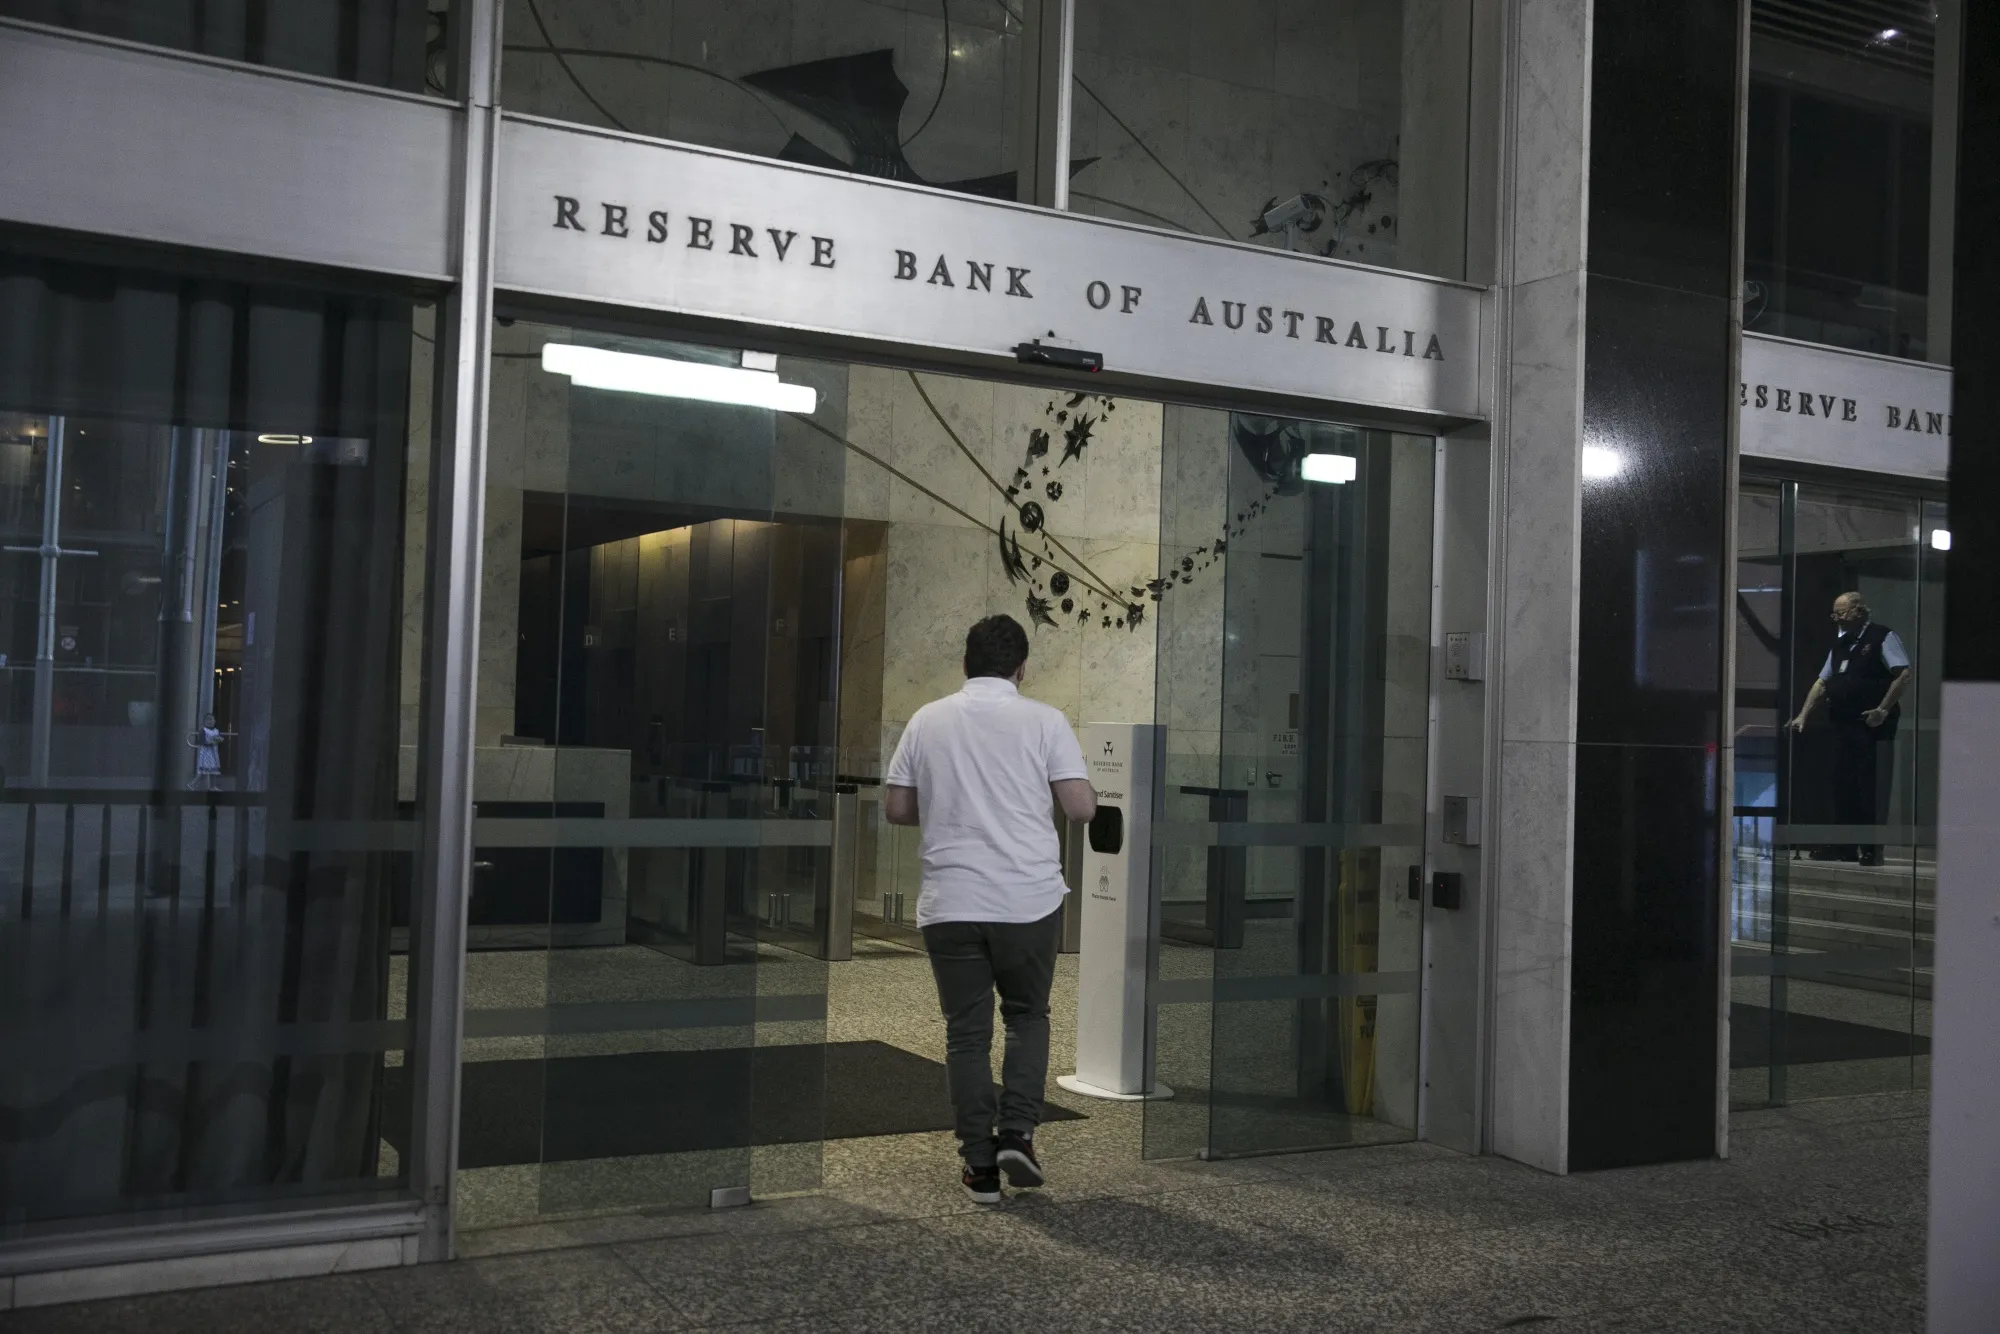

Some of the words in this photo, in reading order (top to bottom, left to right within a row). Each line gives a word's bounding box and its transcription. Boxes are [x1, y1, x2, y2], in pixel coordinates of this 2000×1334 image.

[552, 195, 837, 269] RESERVE
[892, 248, 1034, 300] BANK
[1086, 279, 1143, 314] OF
[1188, 295, 1445, 362] AUSTRALIA
[1740, 382, 1858, 423] ESERVE
[1886, 405, 1952, 437] BAN
[584, 632, 593, 645] D
[668, 626, 677, 640] E
[1104, 790, 1123, 799] Sanitiser
